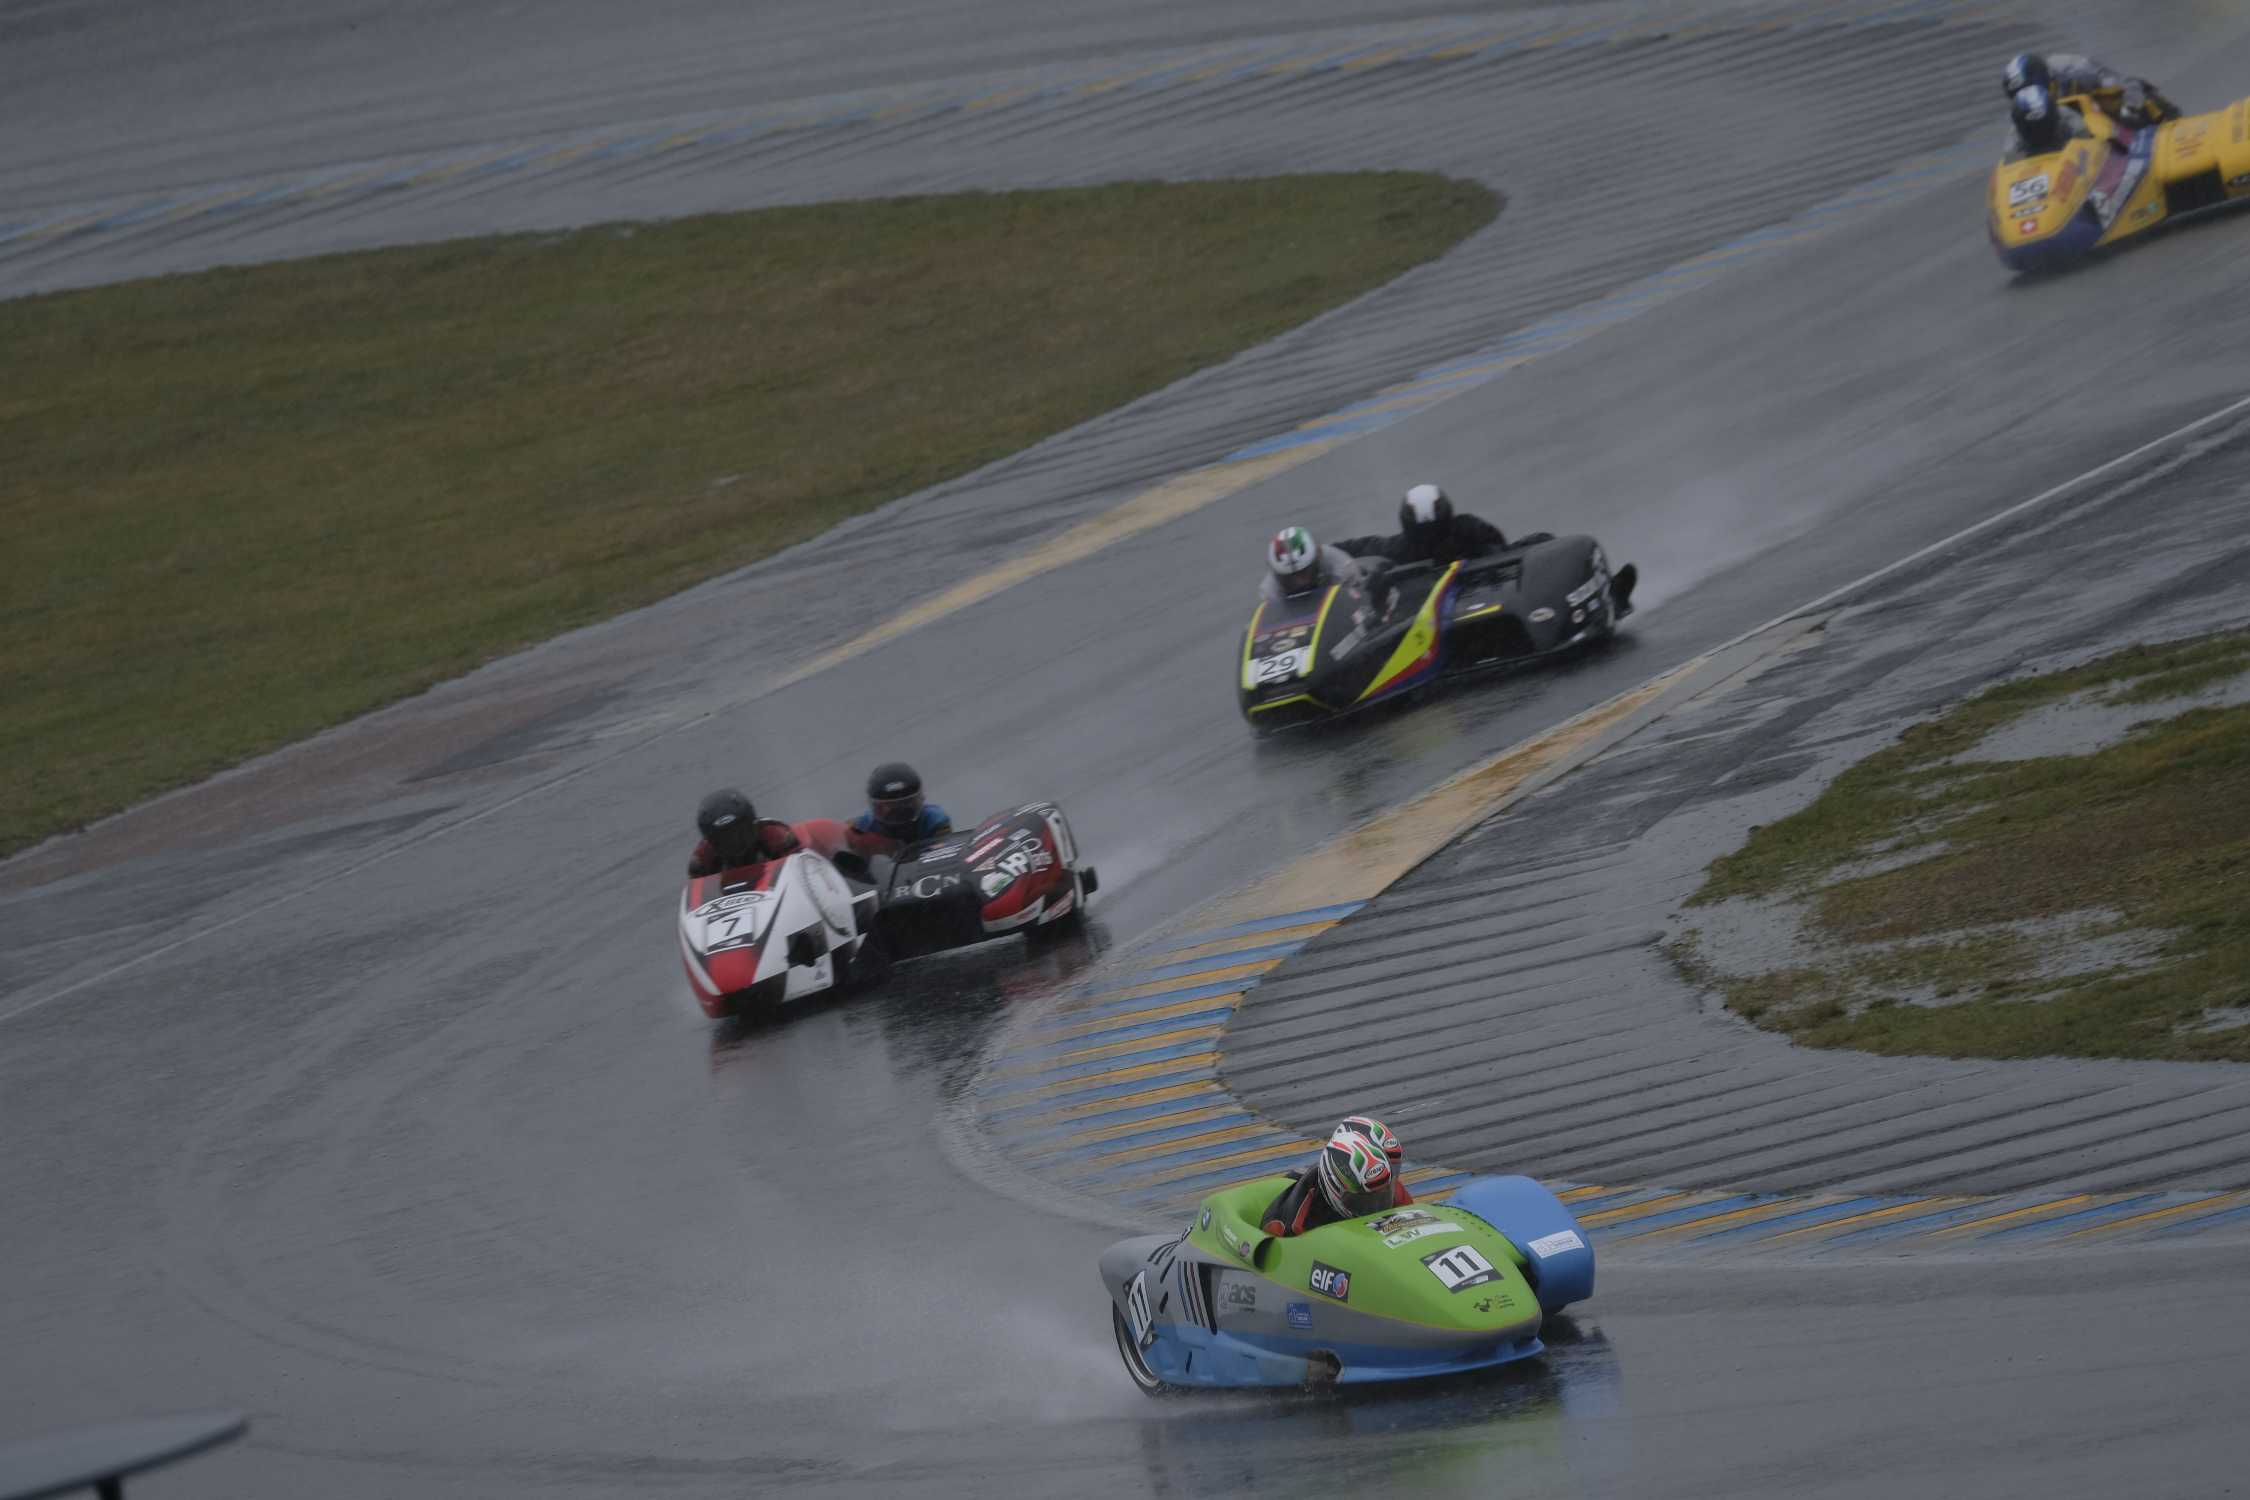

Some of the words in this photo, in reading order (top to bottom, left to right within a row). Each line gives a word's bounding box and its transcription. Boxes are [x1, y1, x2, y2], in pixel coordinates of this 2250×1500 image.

[1260, 655, 1297, 676] 29
[721, 916, 741, 937] 7
[1438, 1251, 1481, 1279] 11
[1311, 1268, 1335, 1291] elf
[1131, 1282, 1149, 1332] 11
